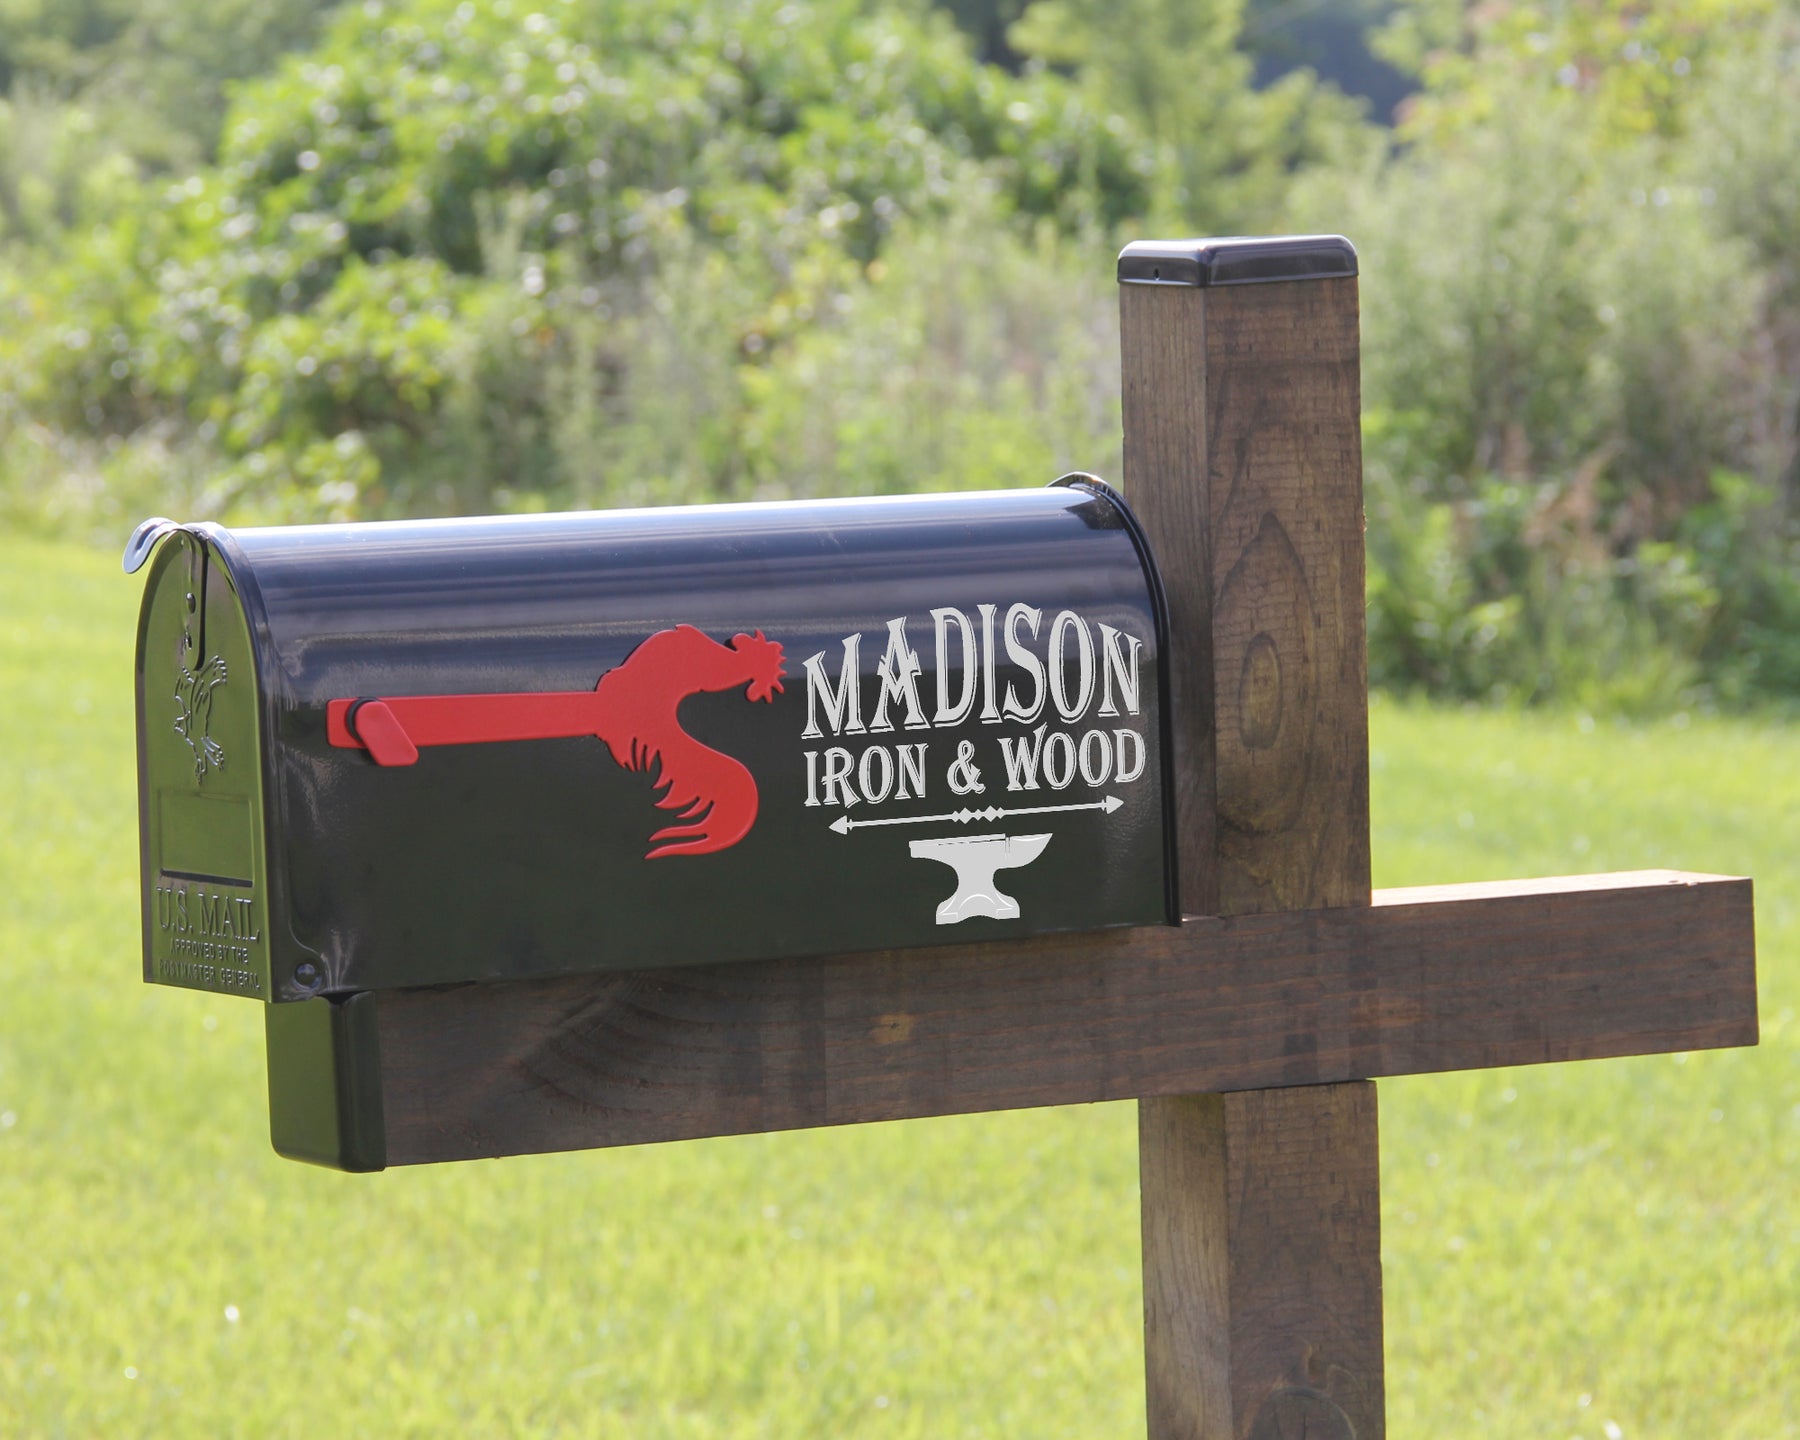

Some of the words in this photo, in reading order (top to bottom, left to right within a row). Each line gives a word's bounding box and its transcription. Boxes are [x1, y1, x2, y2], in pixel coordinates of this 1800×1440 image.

[801, 602, 1143, 739] MADISON
[803, 743, 929, 808] IRON
[946, 739, 986, 795] &
[996, 721, 1146, 791] WOOD
[156, 886, 194, 934] U.S.
[198, 892, 260, 943] MAIL
[231, 946, 248, 965] THE
